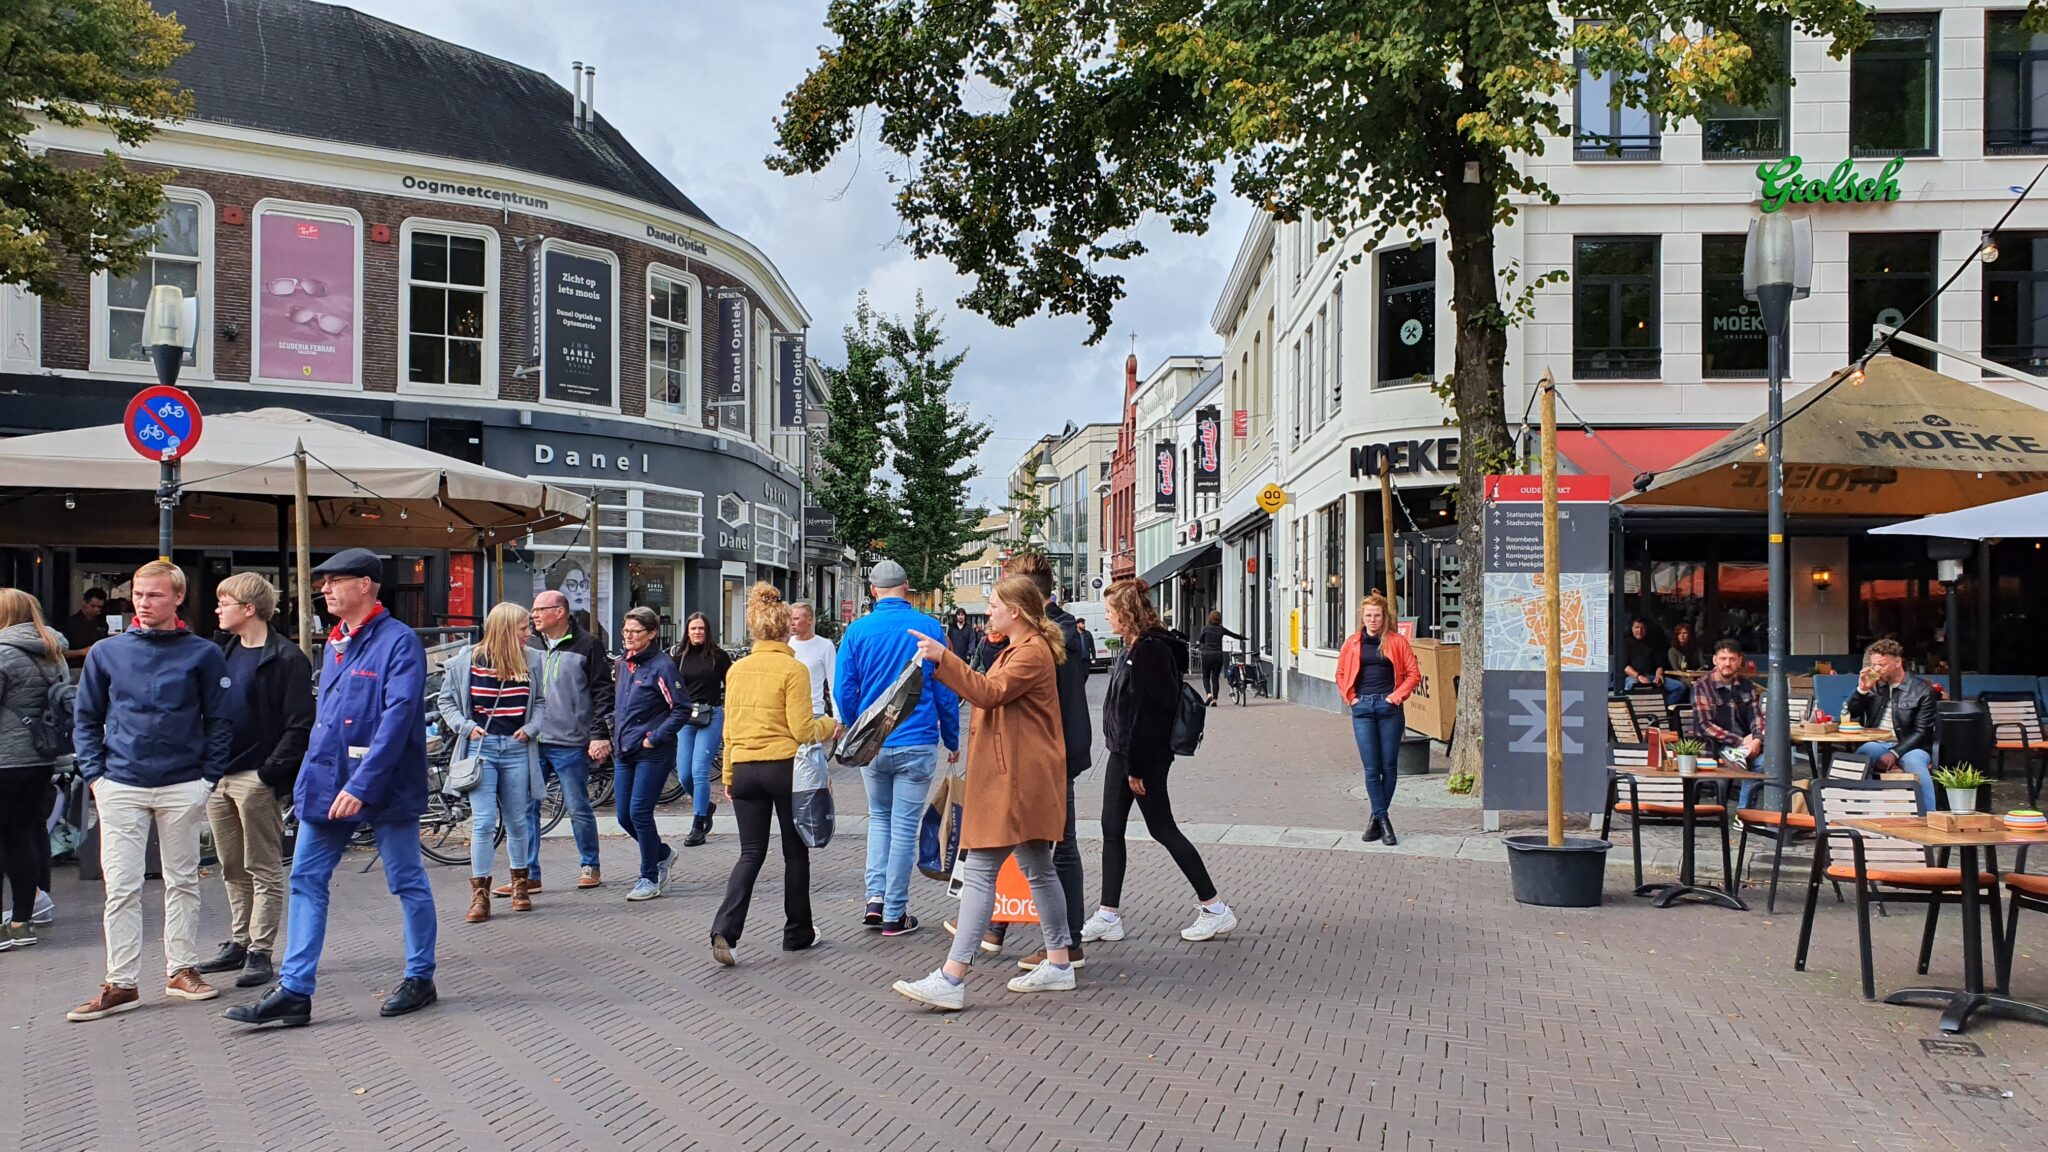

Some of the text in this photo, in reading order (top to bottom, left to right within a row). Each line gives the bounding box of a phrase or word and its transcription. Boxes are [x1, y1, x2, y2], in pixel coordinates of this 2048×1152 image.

[402, 175, 549, 210] Oogmeetcentrum
[1756, 155, 1905, 213] Grolsch
[646, 225, 708, 256] Danel Optiek
[562, 272, 597, 289] Zicht op
[558, 283, 600, 300] iets moois
[532, 251, 541, 357] Danel Optiek
[556, 308, 574, 318] Danel
[1713, 316, 1764, 331] MOEK
[278, 341, 309, 352] SCUDERIA
[562, 347, 596, 359] DANEL
[731, 301, 741, 393] Danel Optiek
[793, 344, 803, 425] Danel Optiek
[1856, 429, 2048, 454] MOEKE
[535, 444, 648, 473] Danel
[1350, 437, 1459, 478] MOEKE
[1911, 454, 2029, 464] ENSCHEDE
[1520, 486, 1542, 494] OUDE
[719, 531, 750, 551] Danel
[1505, 535, 1539, 543] Roombeek
[1518, 561, 1545, 569] Heekple
